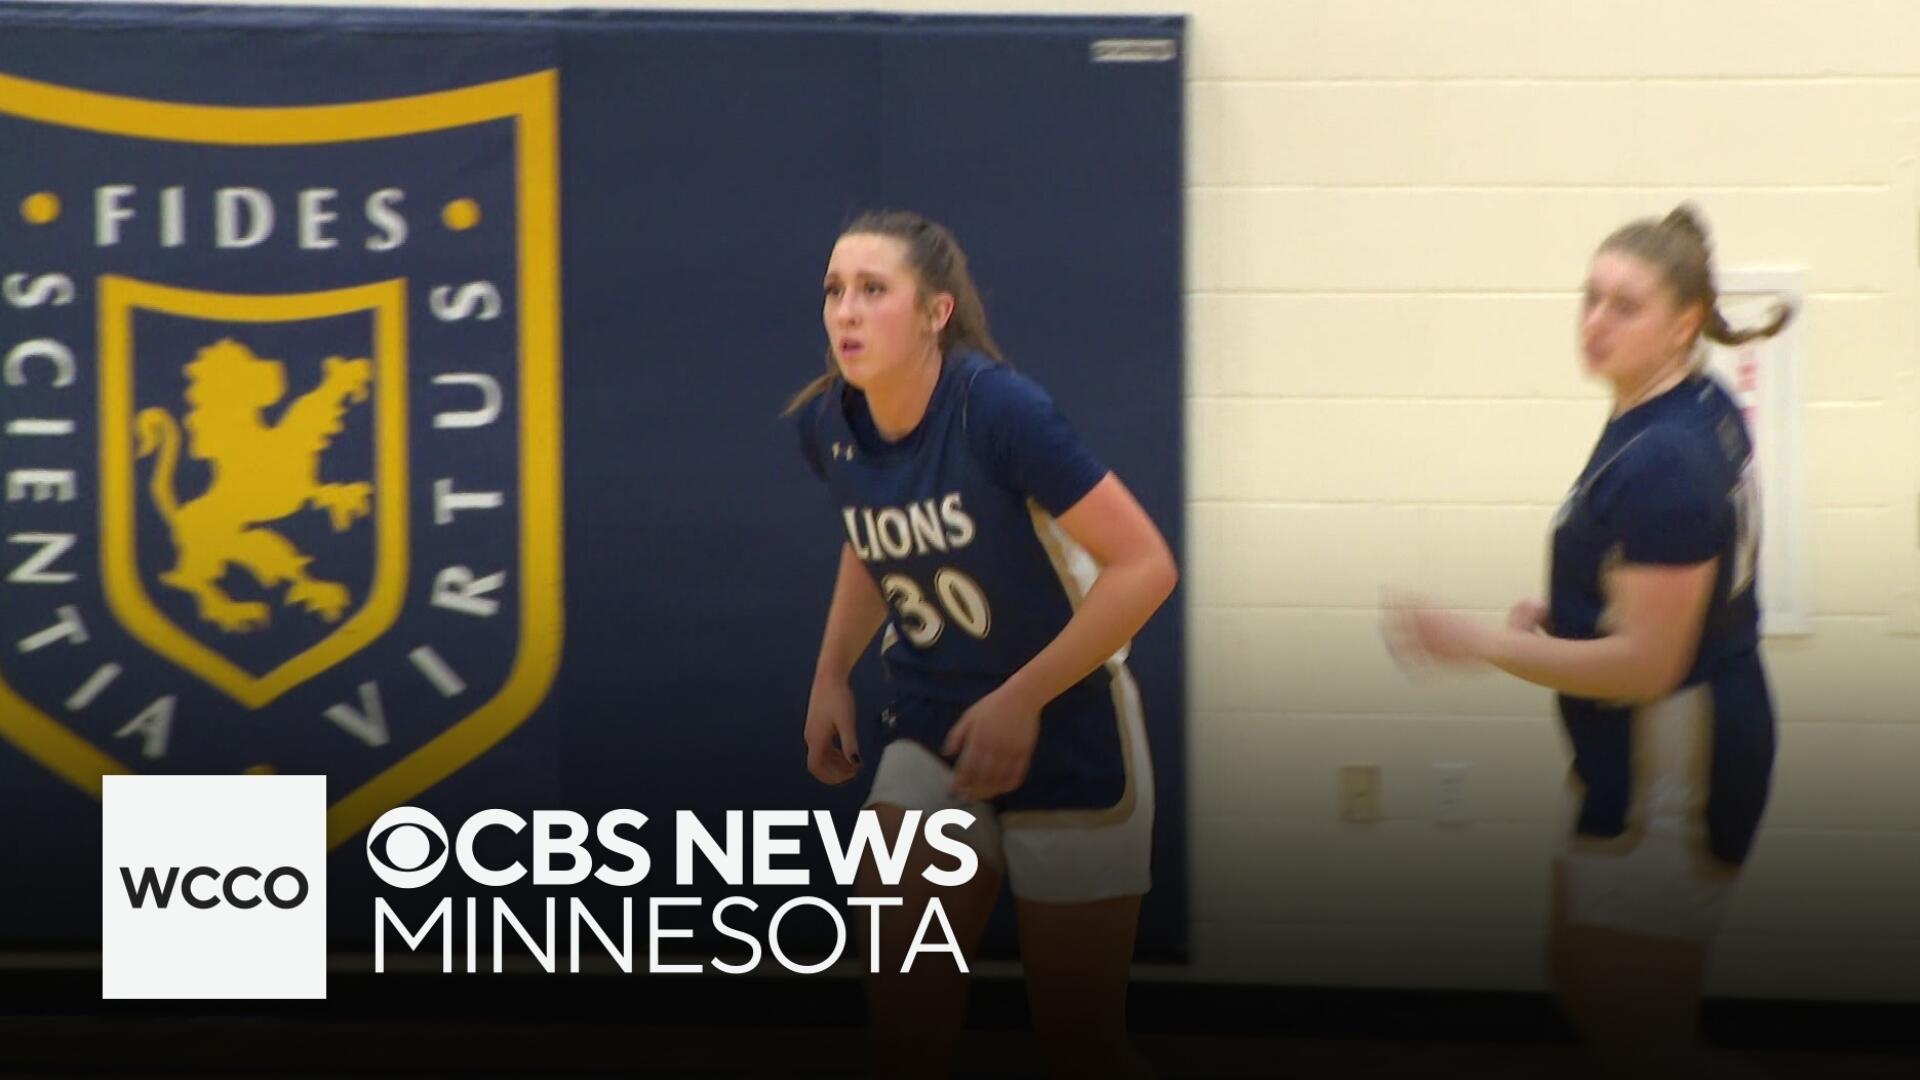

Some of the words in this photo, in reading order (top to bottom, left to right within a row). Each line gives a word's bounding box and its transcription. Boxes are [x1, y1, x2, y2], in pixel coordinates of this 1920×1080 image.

[95, 184, 409, 251] FIDES
[2, 272, 177, 758] SCIENTIA
[323, 280, 506, 747] VIRTUS
[841, 492, 976, 562] LIONS
[881, 567, 992, 648] 30
